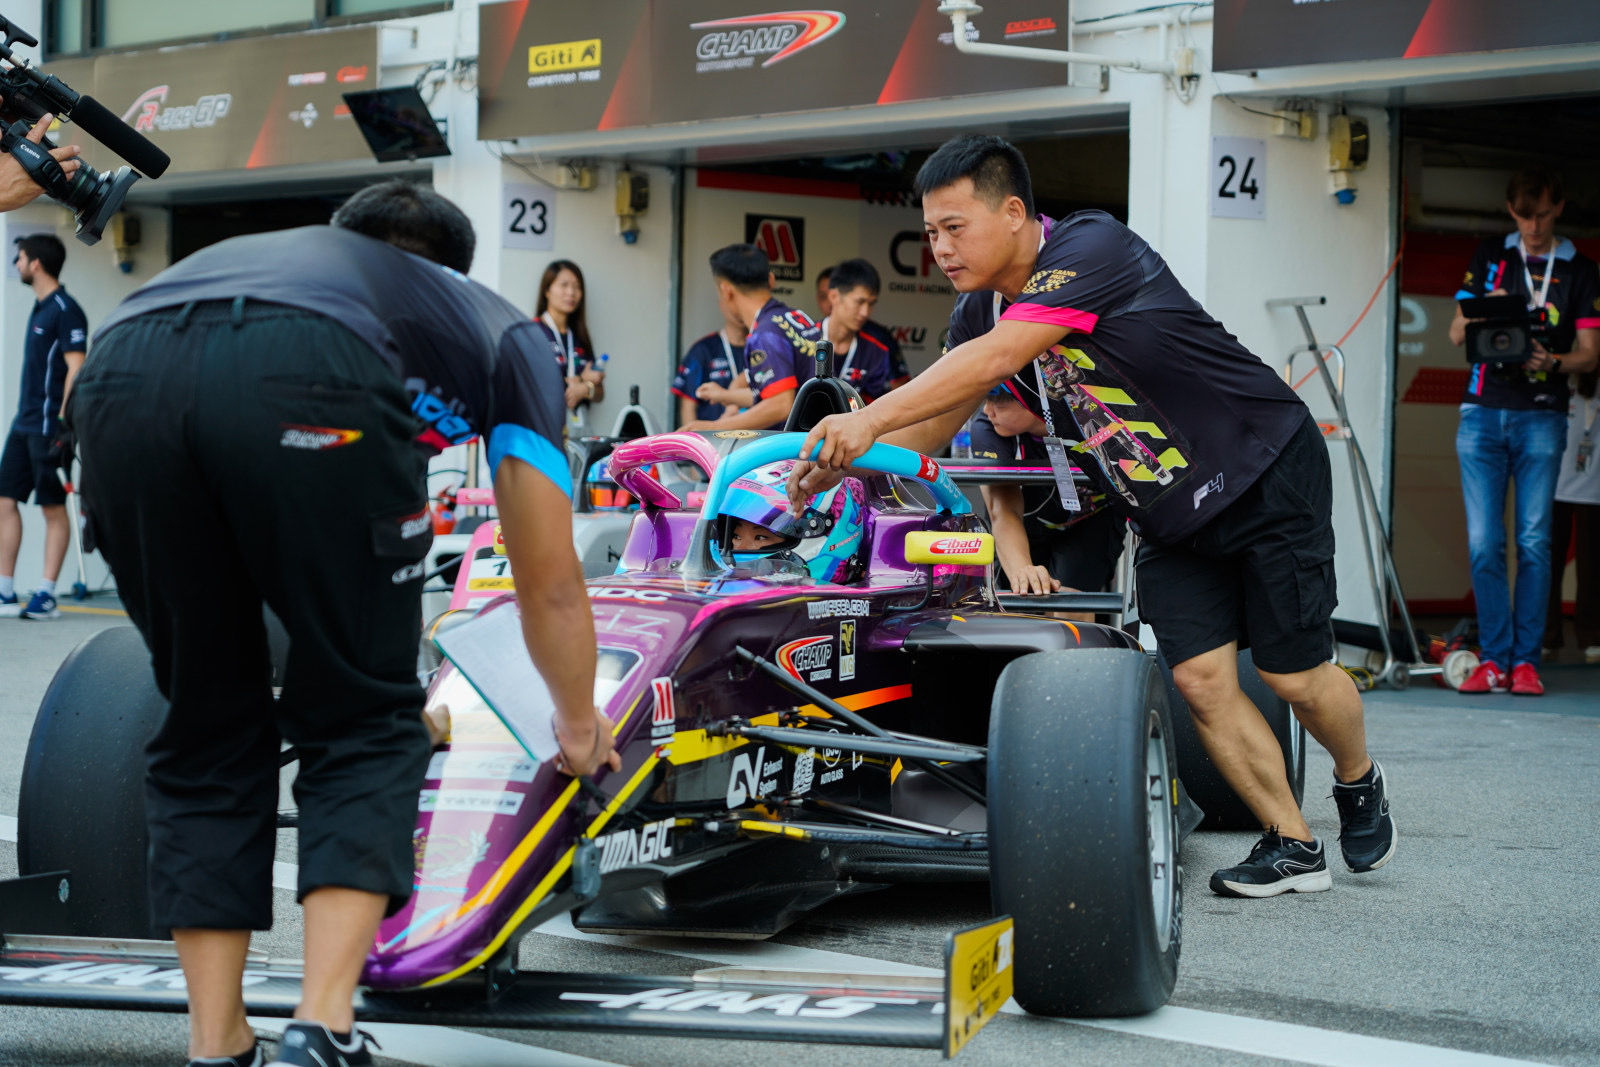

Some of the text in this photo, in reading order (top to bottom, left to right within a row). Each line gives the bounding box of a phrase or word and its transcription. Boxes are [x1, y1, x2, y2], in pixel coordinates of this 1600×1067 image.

[696, 24, 798, 60] CHAMP
[534, 48, 573, 67] Giti
[20, 144, 40, 159] Canon
[1218, 155, 1258, 200] 24
[509, 198, 547, 235] 23
[929, 537, 982, 555] Eibach
[795, 644, 832, 671] CHAMP
[560, 988, 918, 1018] HAAS
